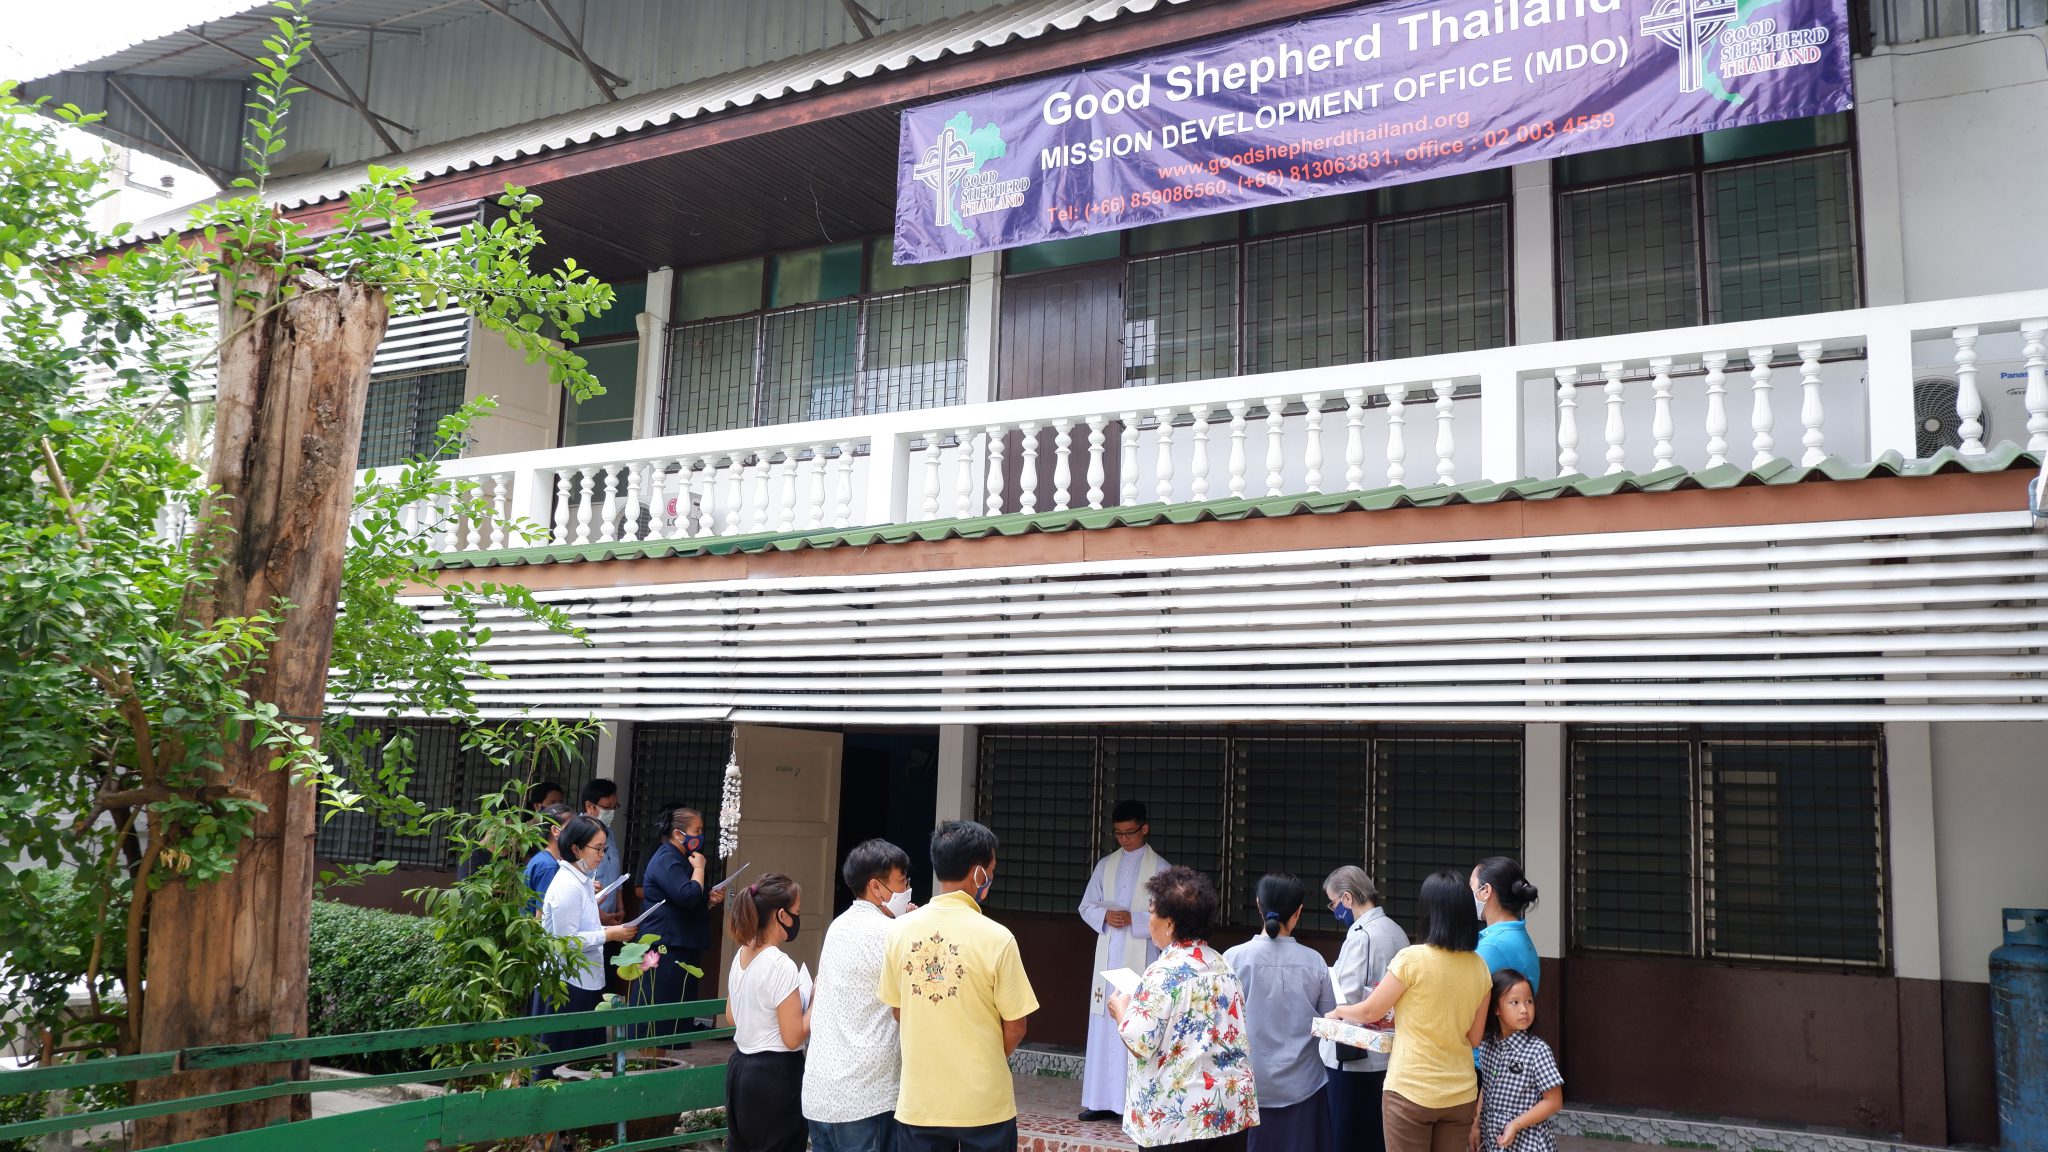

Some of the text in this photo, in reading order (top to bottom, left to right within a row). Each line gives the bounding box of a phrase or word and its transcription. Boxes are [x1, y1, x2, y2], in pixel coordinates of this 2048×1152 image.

[1720, 18, 1776, 46] GOOD
[1720, 26, 1829, 64] SHEPHERD
[1043, 73, 1150, 126] Good
[1165, 22, 1381, 101] Shepherd
[1719, 45, 1822, 79] THAILAND
[1041, 35, 1629, 170] MISSION DEVELOPMENT OFFICE (MDO)
[1157, 110, 1470, 180] www.goodshepherdthailand.org
[961, 169, 999, 189] GOOD
[1047, 206, 1079, 223] Tel:
[1084, 195, 1126, 222] (+66)
[1130, 179, 1232, 209] 859086560,
[1237, 168, 1284, 195] (+66)
[1289, 148, 1399, 183] 813063831,
[1405, 140, 1465, 162] office
[1484, 128, 1510, 149] 02
[1515, 119, 1556, 144] 003
[1561, 111, 1615, 135] 4559
[960, 192, 1025, 217] THAILAND
[961, 176, 1031, 204] SHEPHERD
